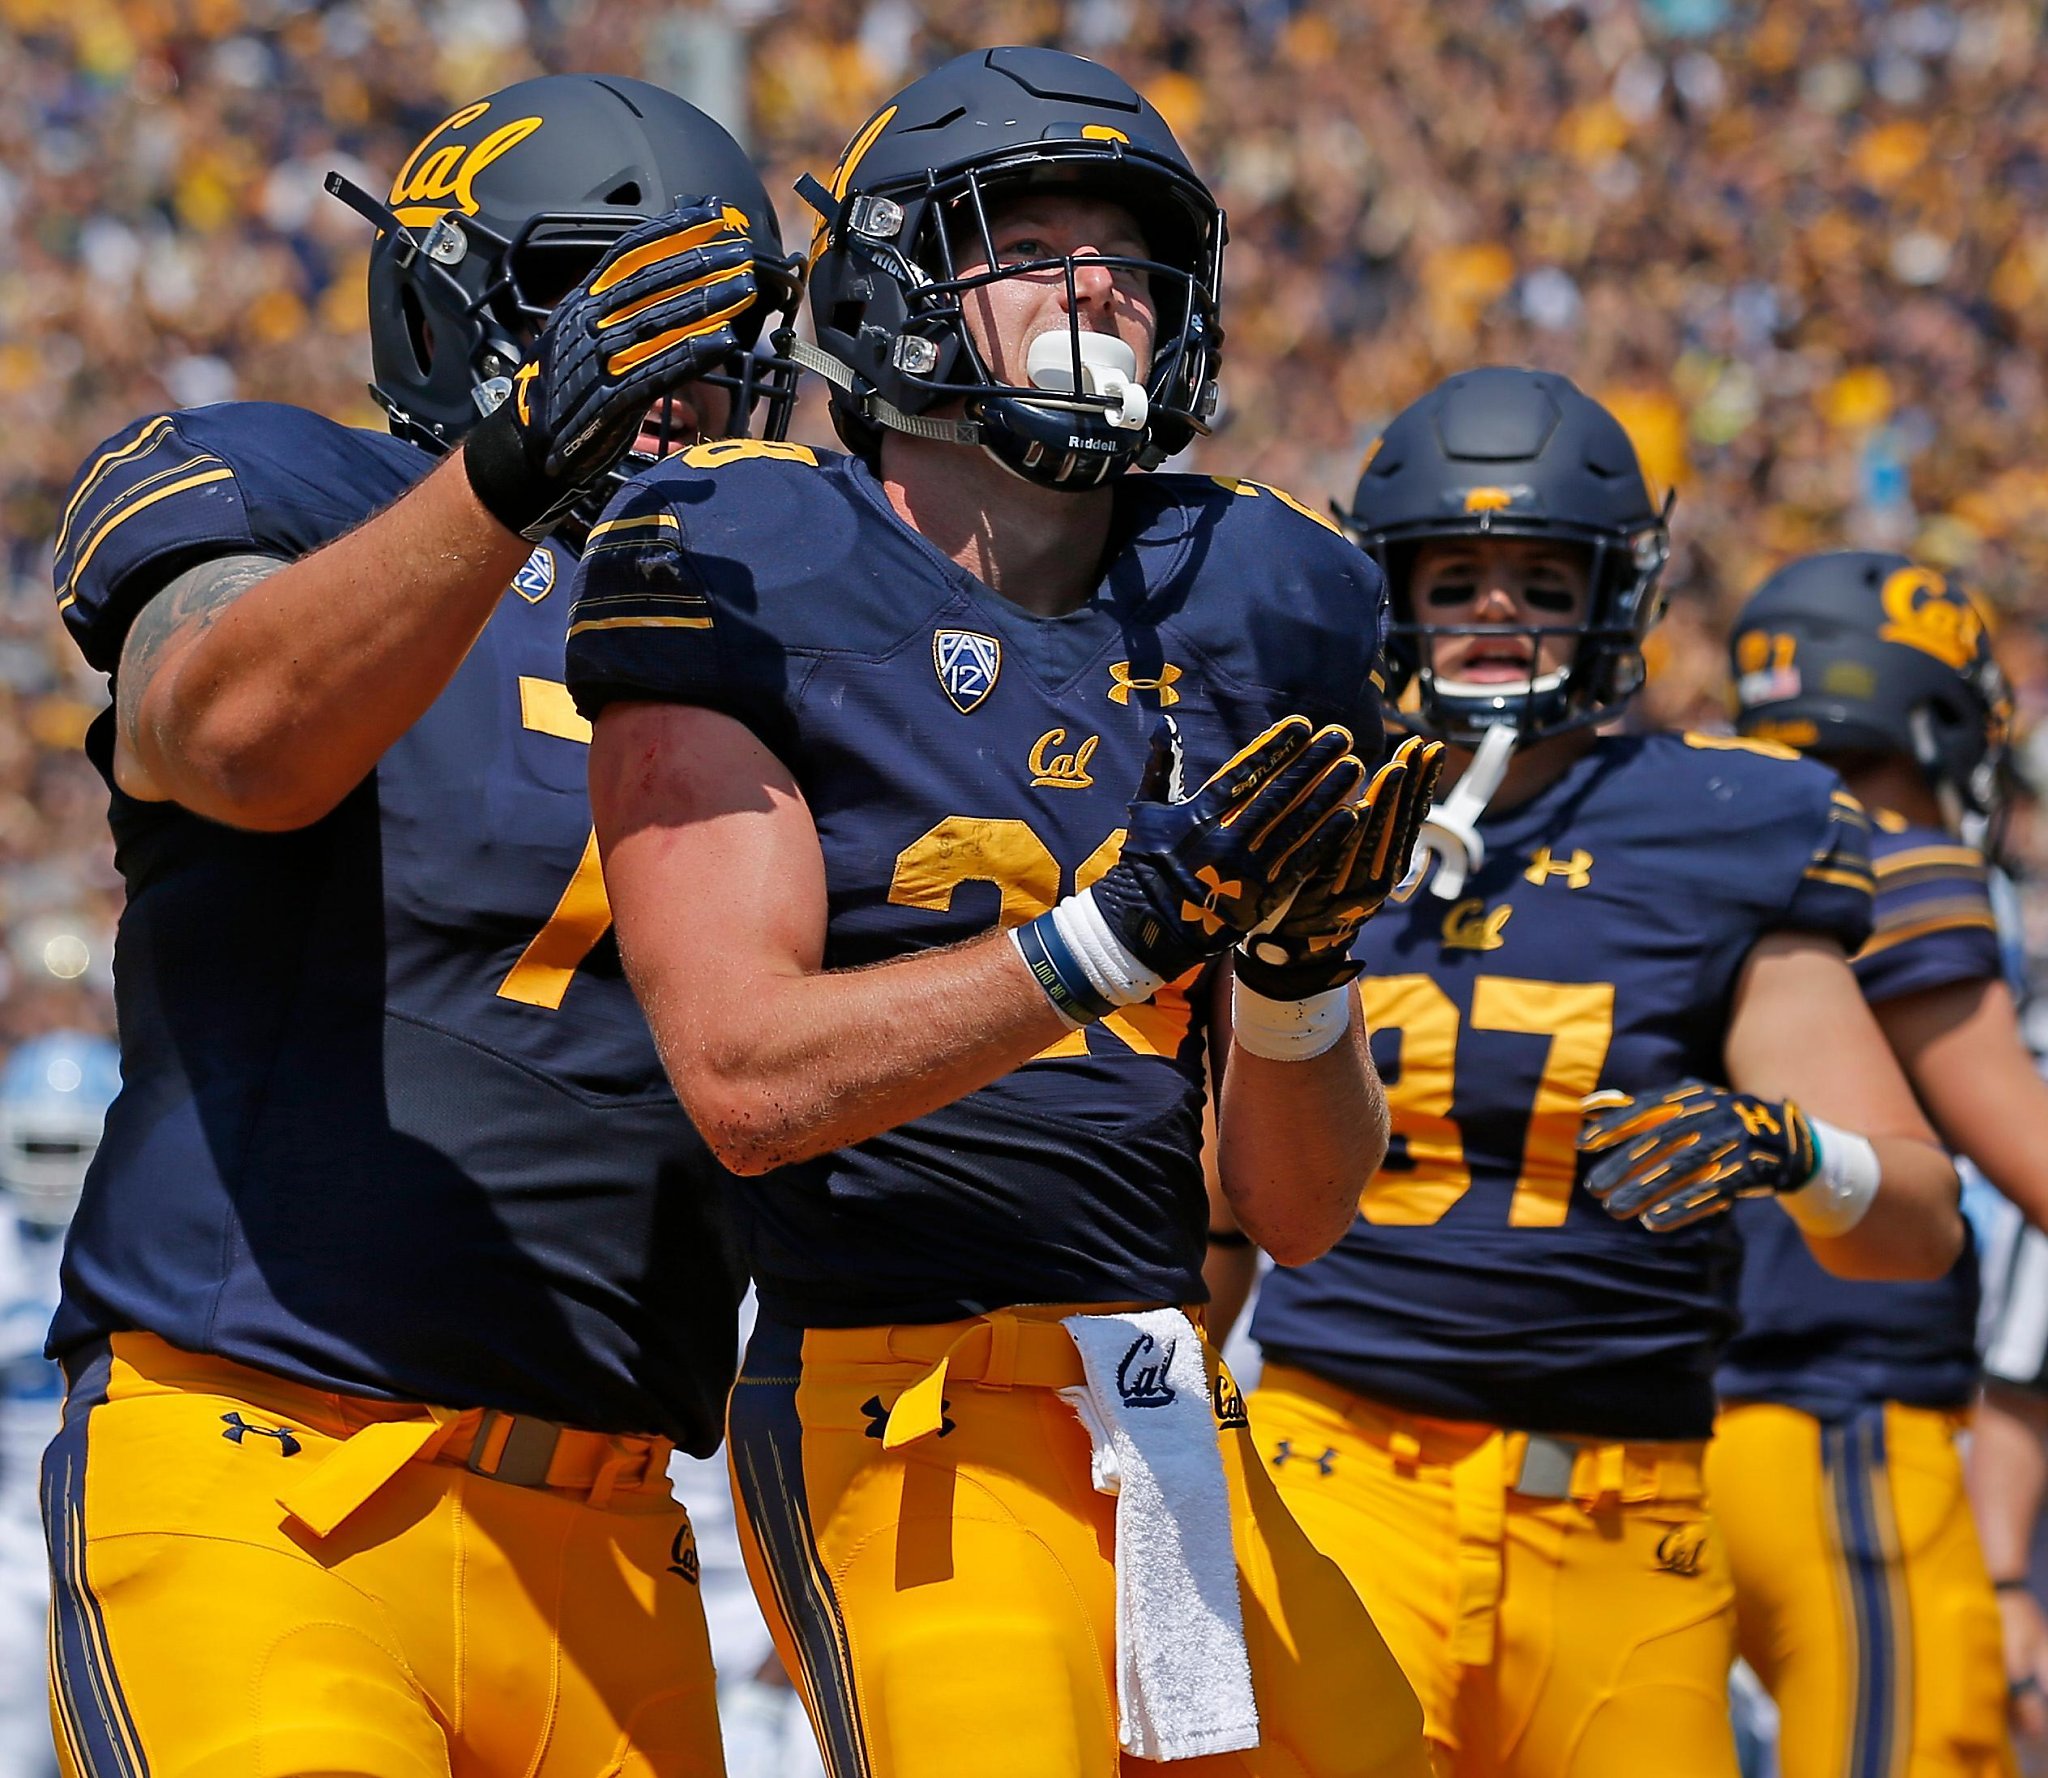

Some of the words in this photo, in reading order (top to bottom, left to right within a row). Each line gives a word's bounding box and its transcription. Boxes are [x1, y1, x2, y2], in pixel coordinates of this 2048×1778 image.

[389, 101, 544, 218] Cal
[1068, 435, 1117, 452] Riddell
[938, 633, 995, 684] PAC
[950, 665, 983, 696] 12
[1028, 728, 1099, 789] Cal
[1440, 898, 1513, 951] Cal
[1032, 960, 1056, 986] QUIT
[1049, 983, 1067, 1000] OR
[1358, 973, 1615, 1228] 87
[1116, 1333, 1178, 1409] Cal
